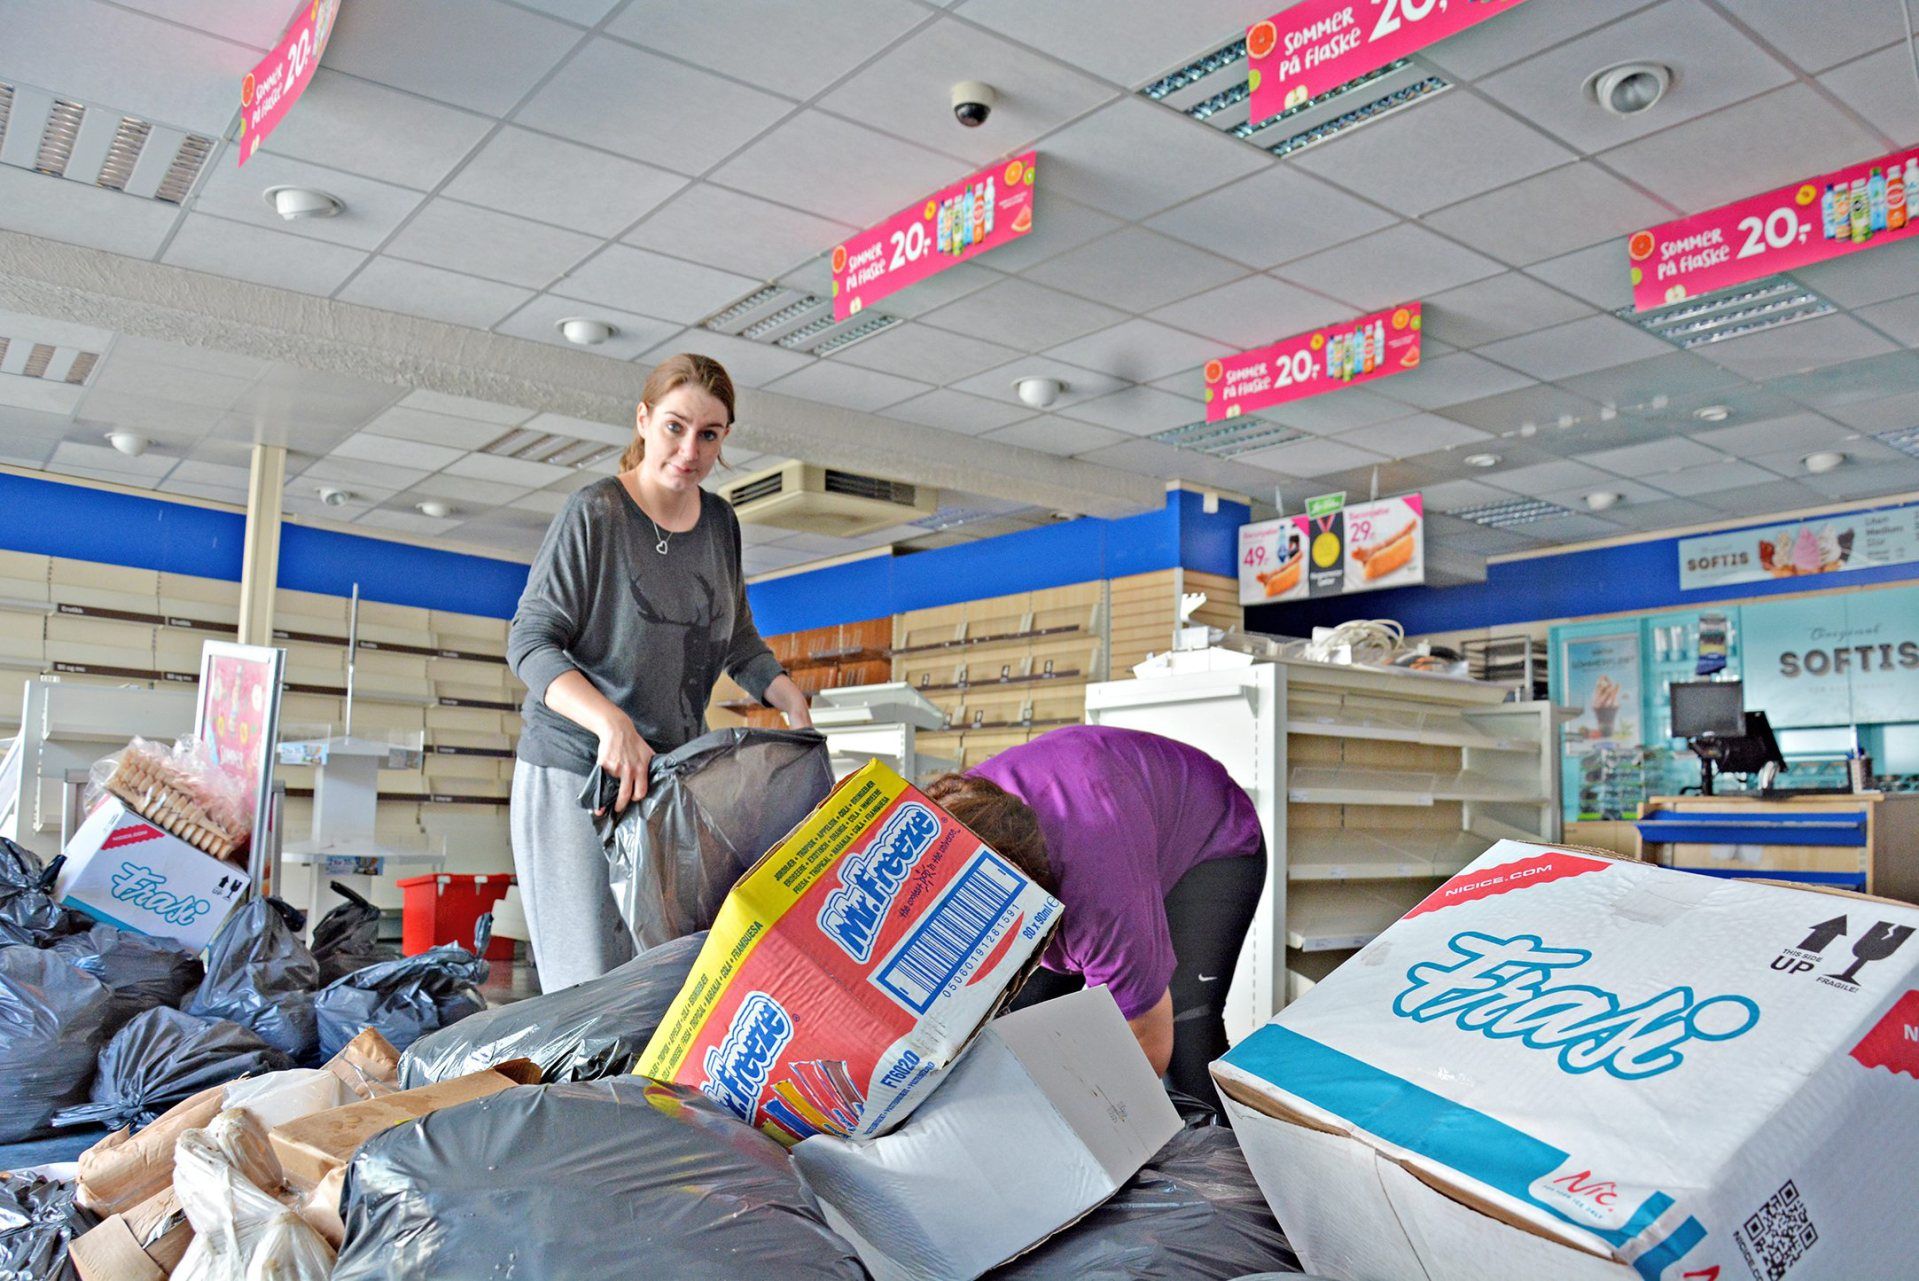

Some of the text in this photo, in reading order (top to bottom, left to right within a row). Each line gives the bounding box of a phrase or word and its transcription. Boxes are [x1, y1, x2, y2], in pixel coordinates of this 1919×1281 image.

[1279, 55, 1301, 82] PÅ
[1687, 551, 1748, 572] SOFTIS
[1779, 640, 1919, 678] SOFTIS
[838, 806, 851, 818] COLA
[847, 811, 860, 823] COLA
[793, 877, 809, 894] FRESA
[852, 822, 865, 835] COLA
[1445, 864, 1552, 897] NICICE.COM
[1022, 928, 1036, 940] 80
[720, 961, 733, 979] COLA
[732, 920, 763, 962] FRAMBUESA
[1782, 948, 1823, 963] THIS SIDE
[1770, 955, 1815, 974] UP
[1816, 976, 1860, 994] FRAGILE!
[880, 1049, 920, 1089] FT6020
